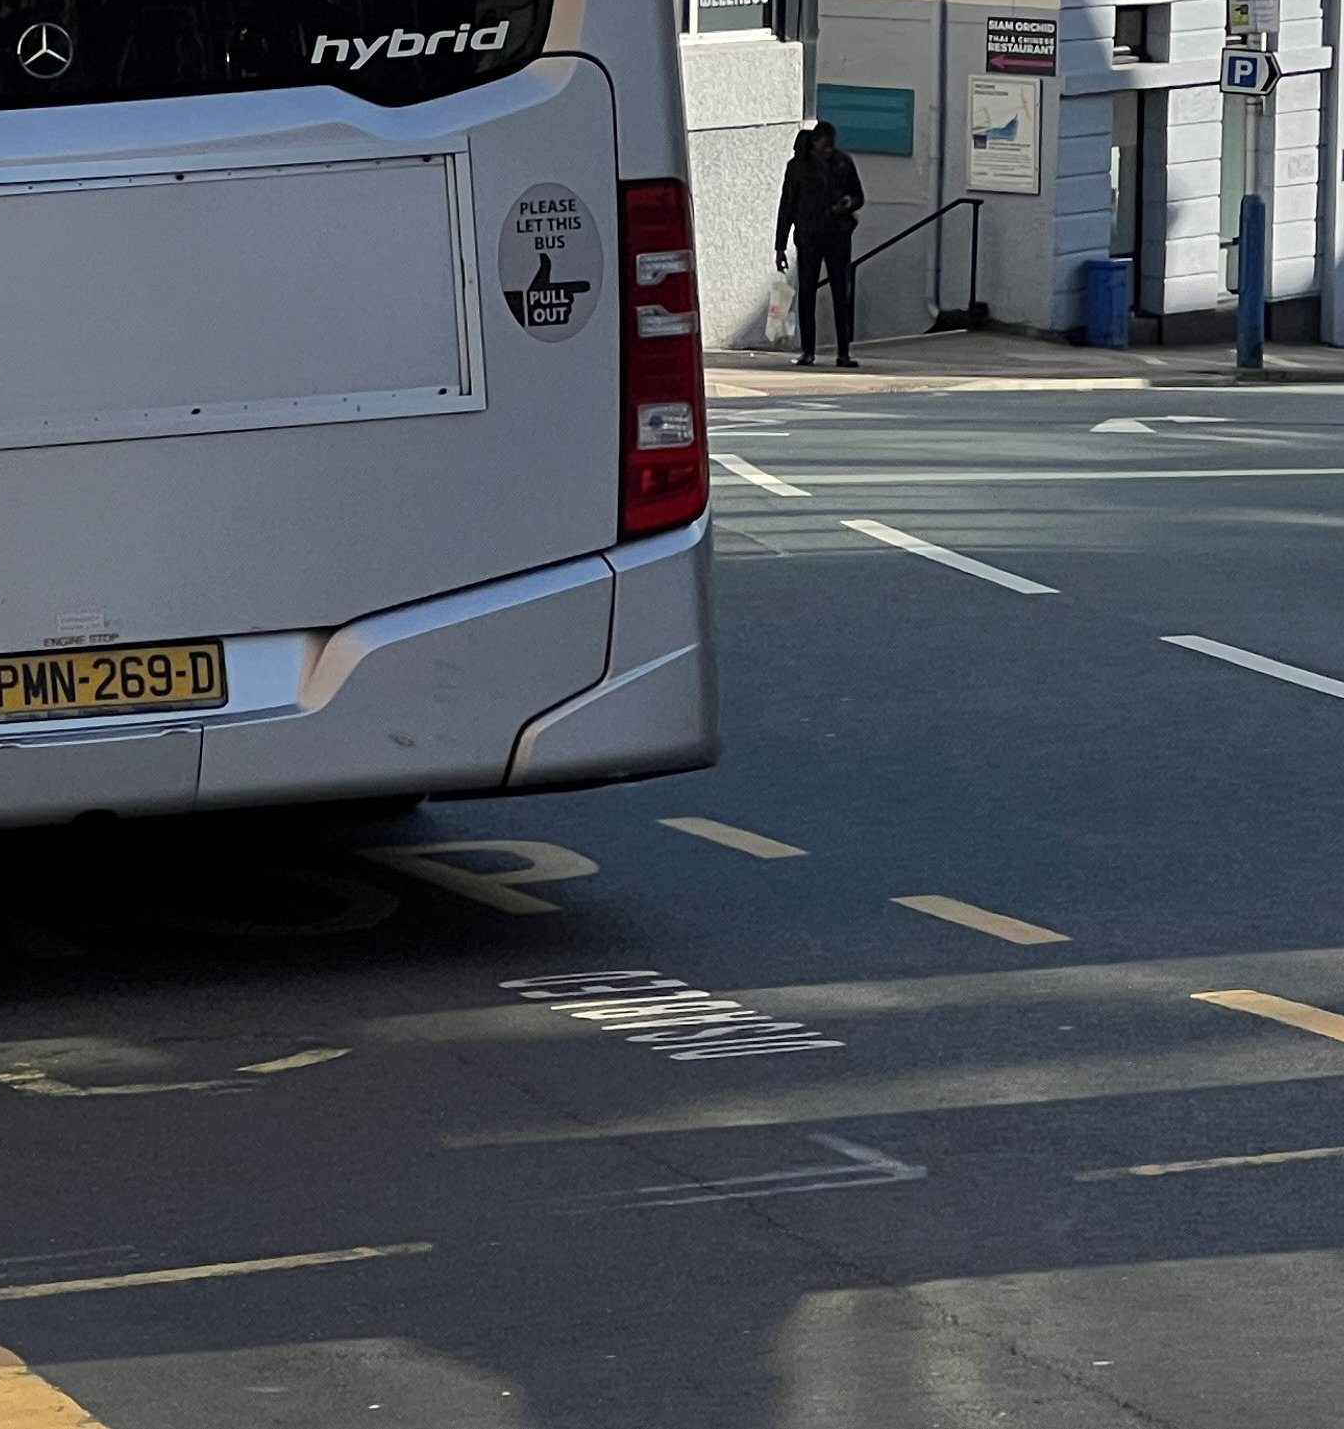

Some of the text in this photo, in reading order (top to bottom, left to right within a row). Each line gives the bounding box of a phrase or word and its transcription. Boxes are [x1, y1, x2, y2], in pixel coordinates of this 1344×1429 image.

[988, 20, 1055, 34] SIAM ORCHID
[310, 20, 510, 70] hybrid
[987, 42, 1055, 55] RESTAURANT
[1234, 59, 1254, 84] P
[519, 198, 577, 215] PLEASE
[516, 216, 582, 233] LET THIS
[534, 235, 566, 250] BUS
[529, 289, 570, 306] PULL
[533, 307, 568, 323] OUT
[44, 633, 119, 647] ENGINE STOP
[498, 969, 846, 1062] DISABLED
